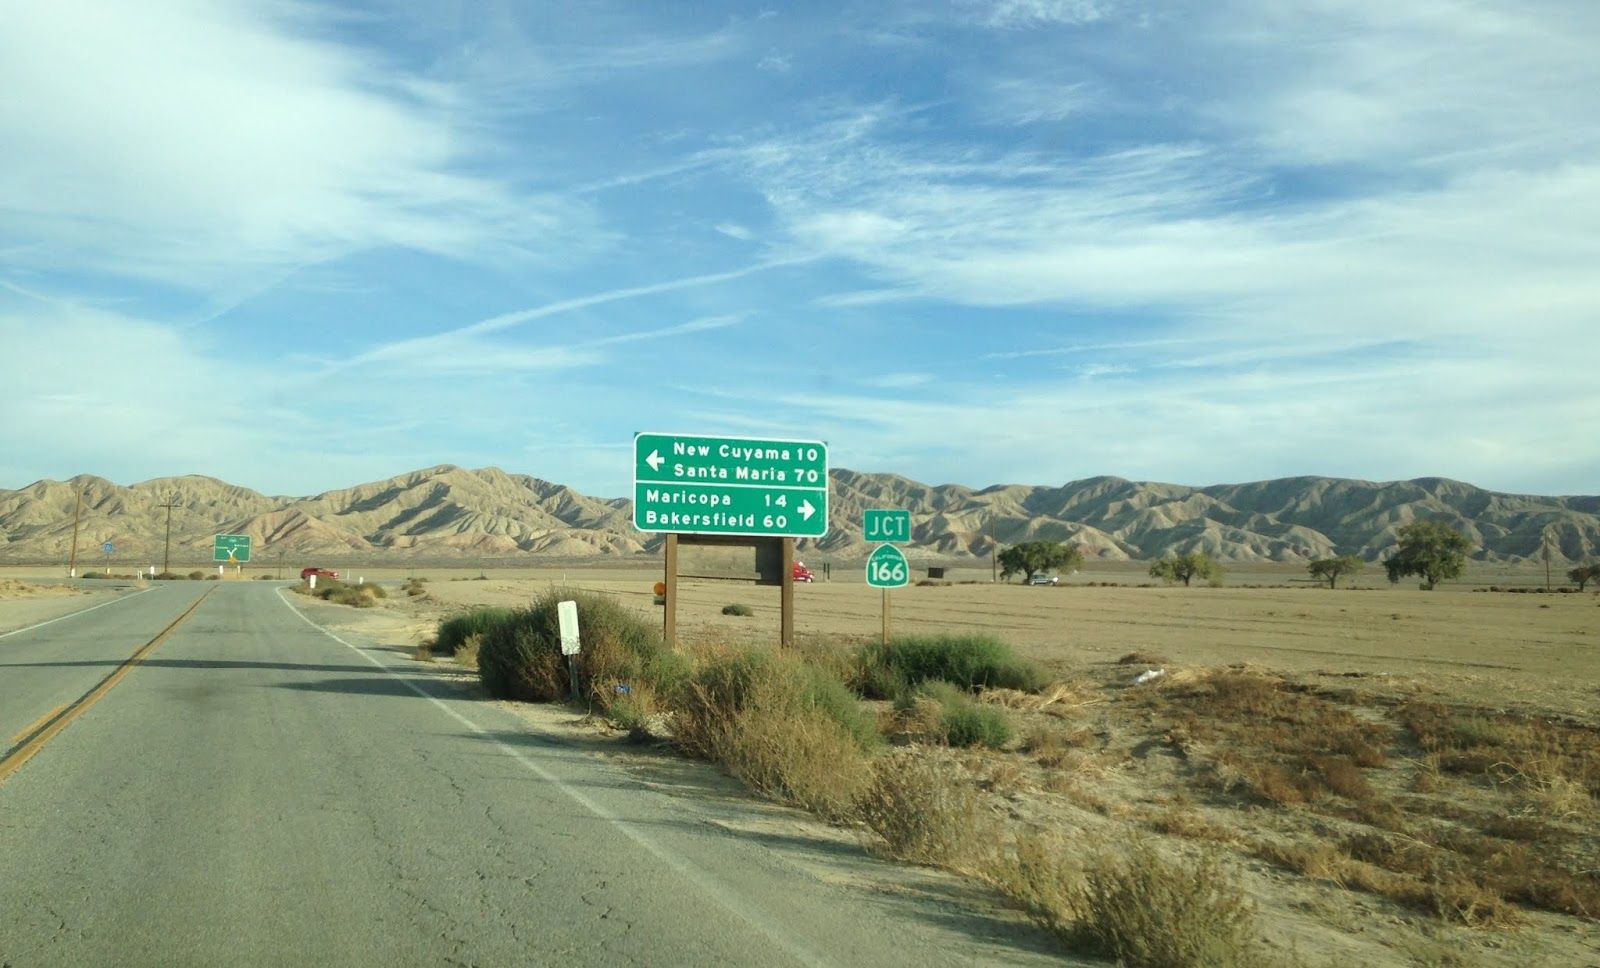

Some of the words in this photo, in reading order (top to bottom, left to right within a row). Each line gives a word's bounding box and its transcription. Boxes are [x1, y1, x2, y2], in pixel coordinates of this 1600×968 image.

[674, 442, 710, 456] New
[719, 444, 790, 461] Cuyama
[797, 449, 818, 461] 10
[674, 464, 728, 478] Santa
[736, 467, 786, 481] Maria
[794, 469, 818, 482] 70
[646, 490, 731, 507] Maricopa
[765, 495, 787, 507] 14
[646, 511, 754, 527] Bakersfield
[763, 515, 787, 528] 60
[869, 516, 905, 536] JCT
[871, 561, 905, 581] 166
